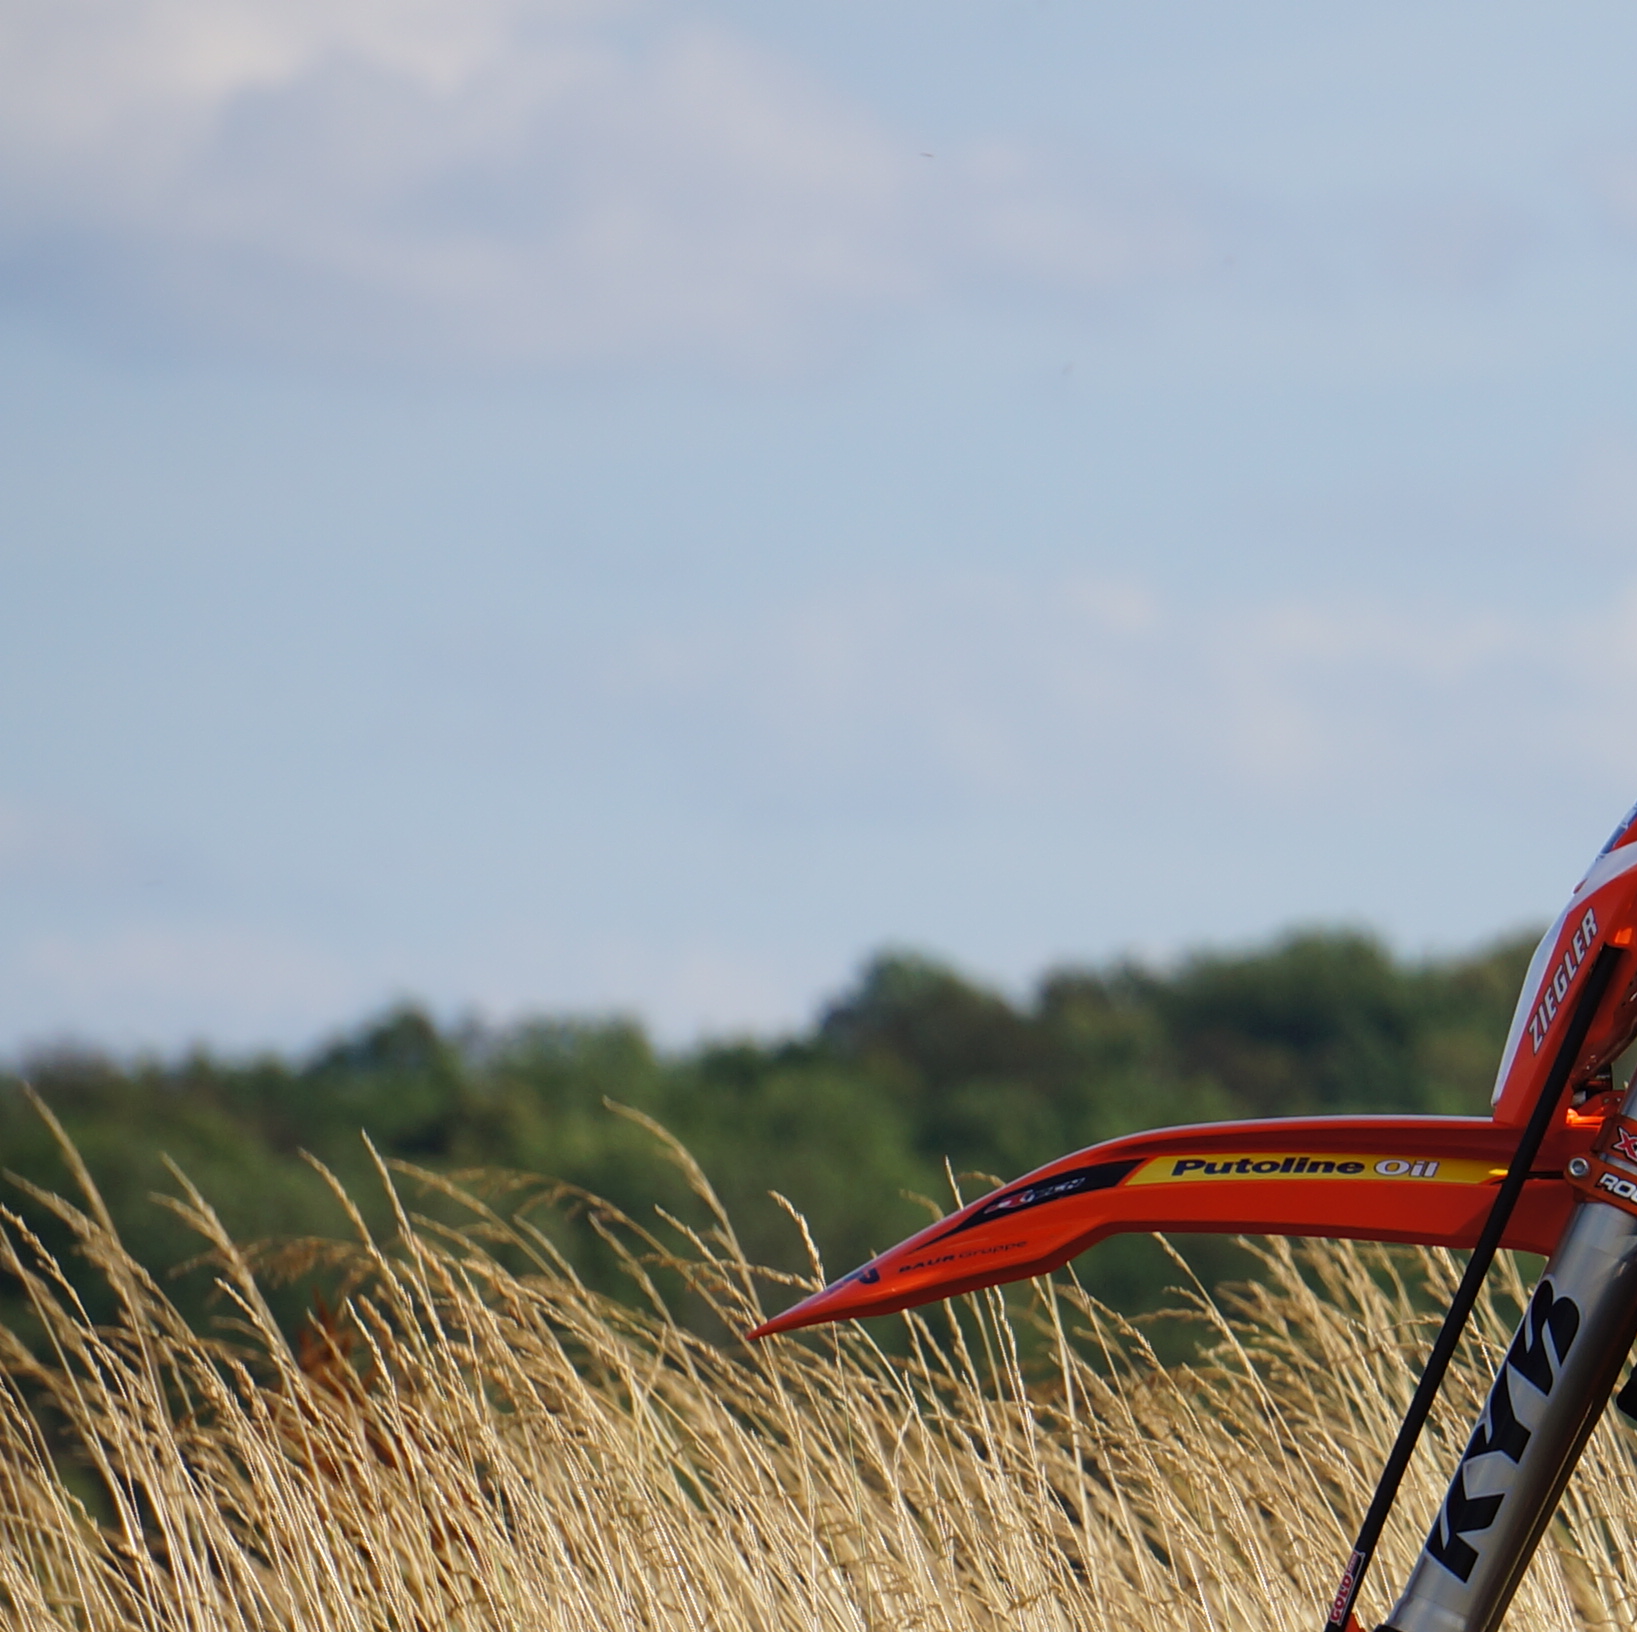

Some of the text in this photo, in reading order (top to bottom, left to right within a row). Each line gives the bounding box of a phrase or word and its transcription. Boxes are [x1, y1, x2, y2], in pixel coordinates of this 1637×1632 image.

[1528, 907, 1598, 1055] ZIEGLER
[1171, 1157, 1440, 1178] Putoline Oil
[1425, 1278, 1581, 1583] KYB
